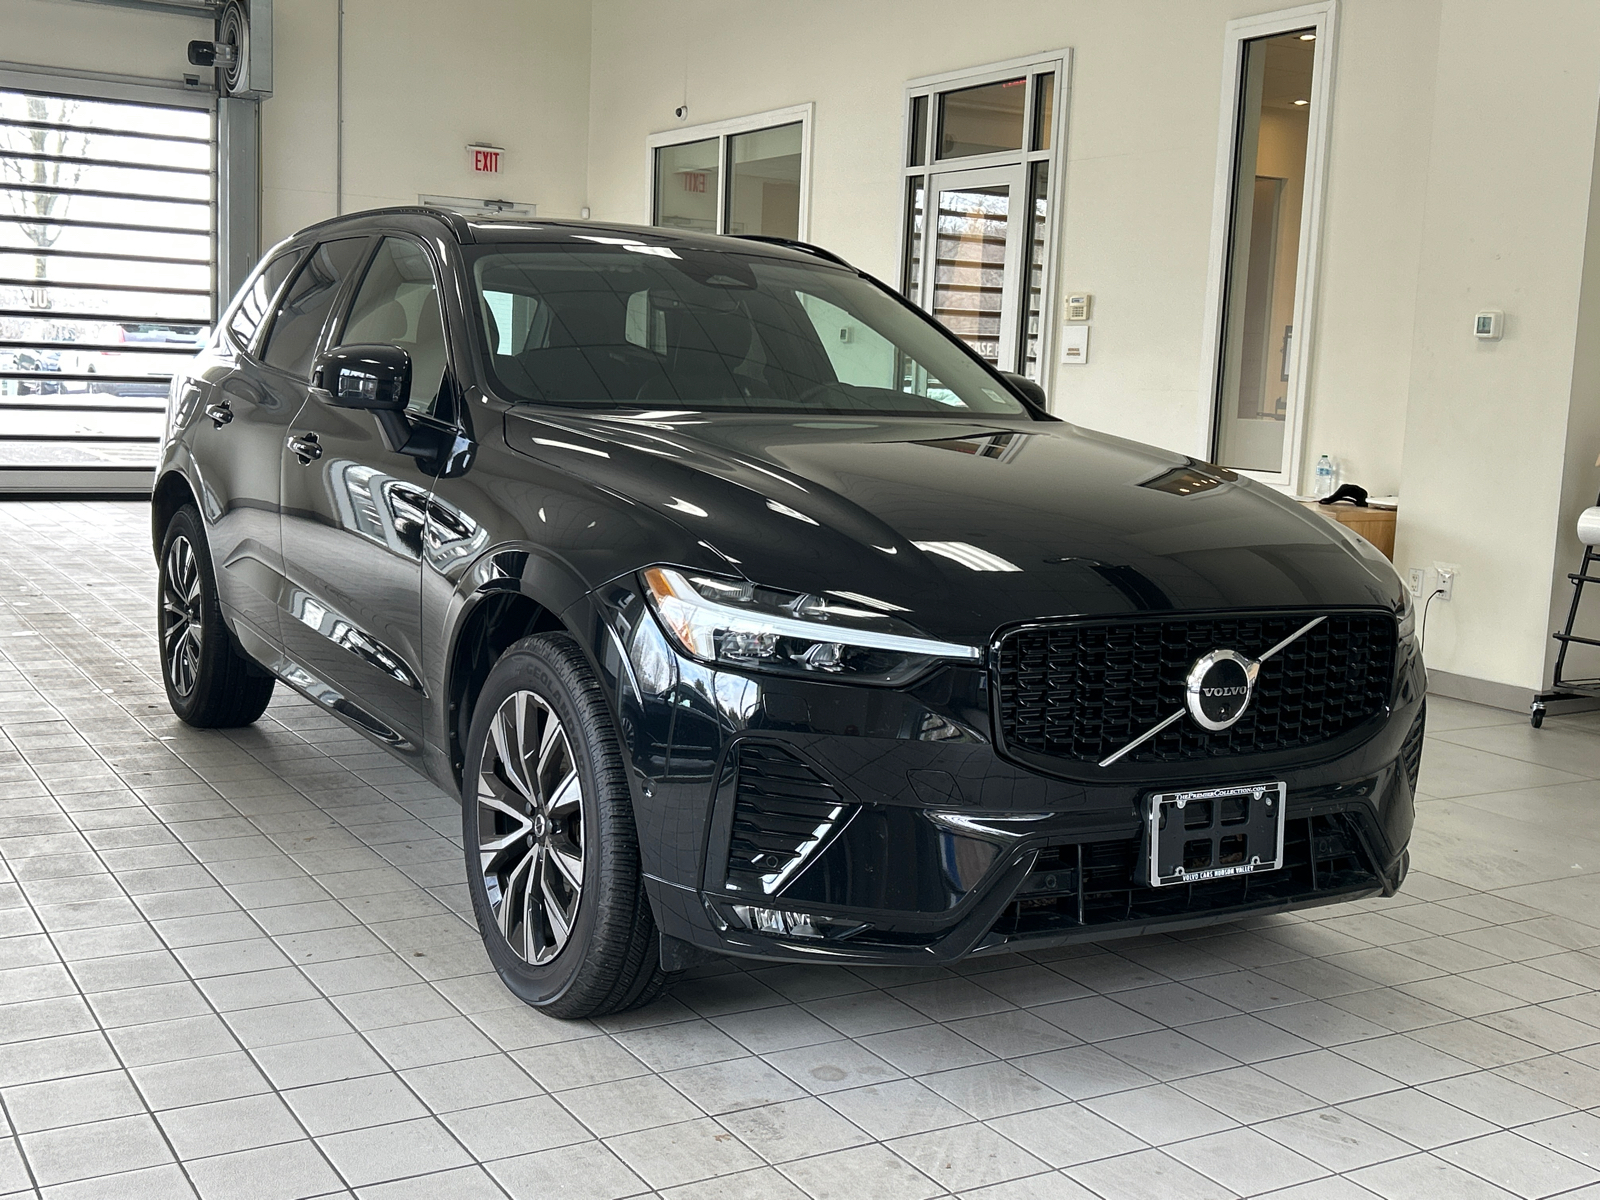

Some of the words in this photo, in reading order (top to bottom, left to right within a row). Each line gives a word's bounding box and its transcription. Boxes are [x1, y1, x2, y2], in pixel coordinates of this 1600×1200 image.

[475, 150, 500, 173] EXIT
[1202, 686, 1247, 697] VOLVO
[1182, 873, 1199, 882] VOLVO
[1214, 869, 1235, 877] HUDSON
[1235, 865, 1254, 873] VALLEY
